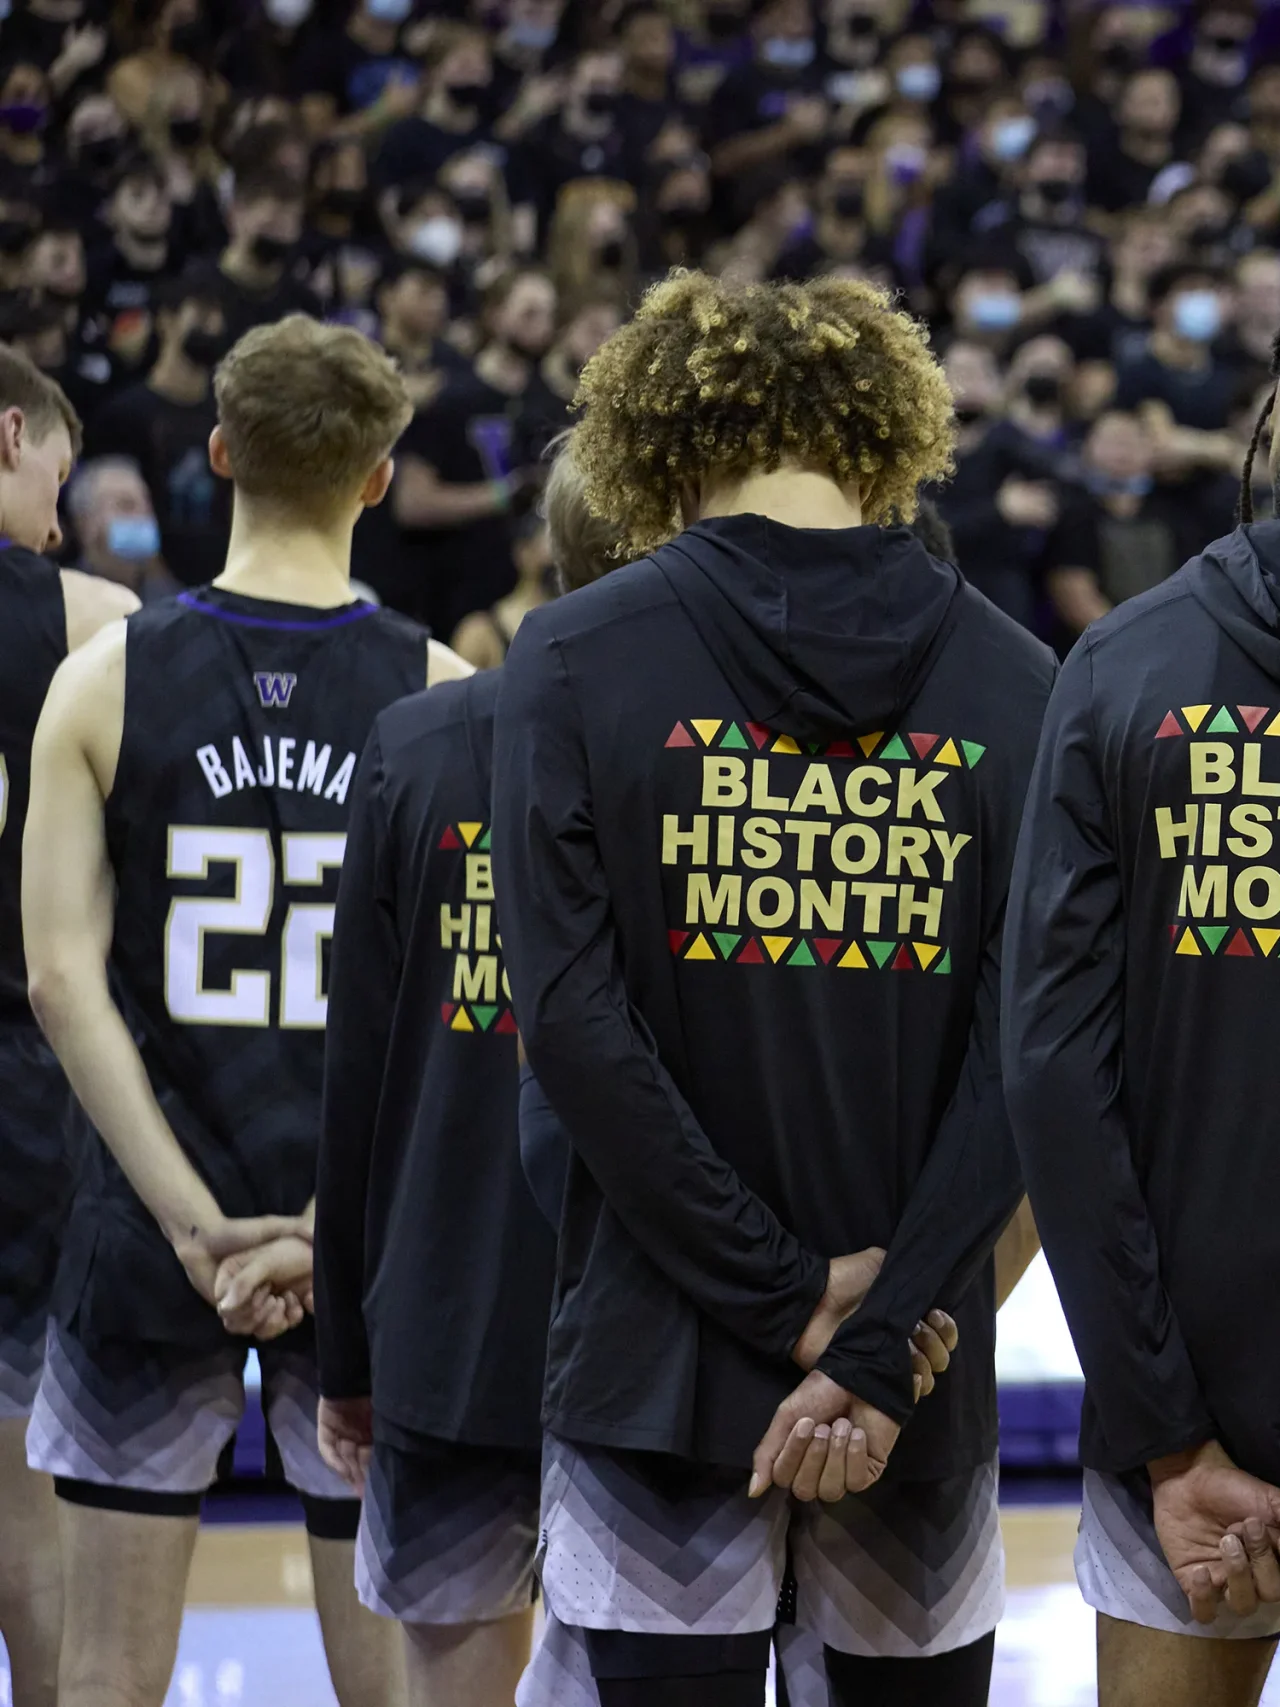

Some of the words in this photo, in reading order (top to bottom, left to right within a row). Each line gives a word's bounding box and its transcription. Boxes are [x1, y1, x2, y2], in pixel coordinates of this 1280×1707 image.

[253, 671, 297, 708] W
[196, 735, 357, 805] BAJEMA
[701, 755, 948, 823] BLACK
[661, 814, 972, 882] HISTORY
[685, 872, 944, 937] MONTH
